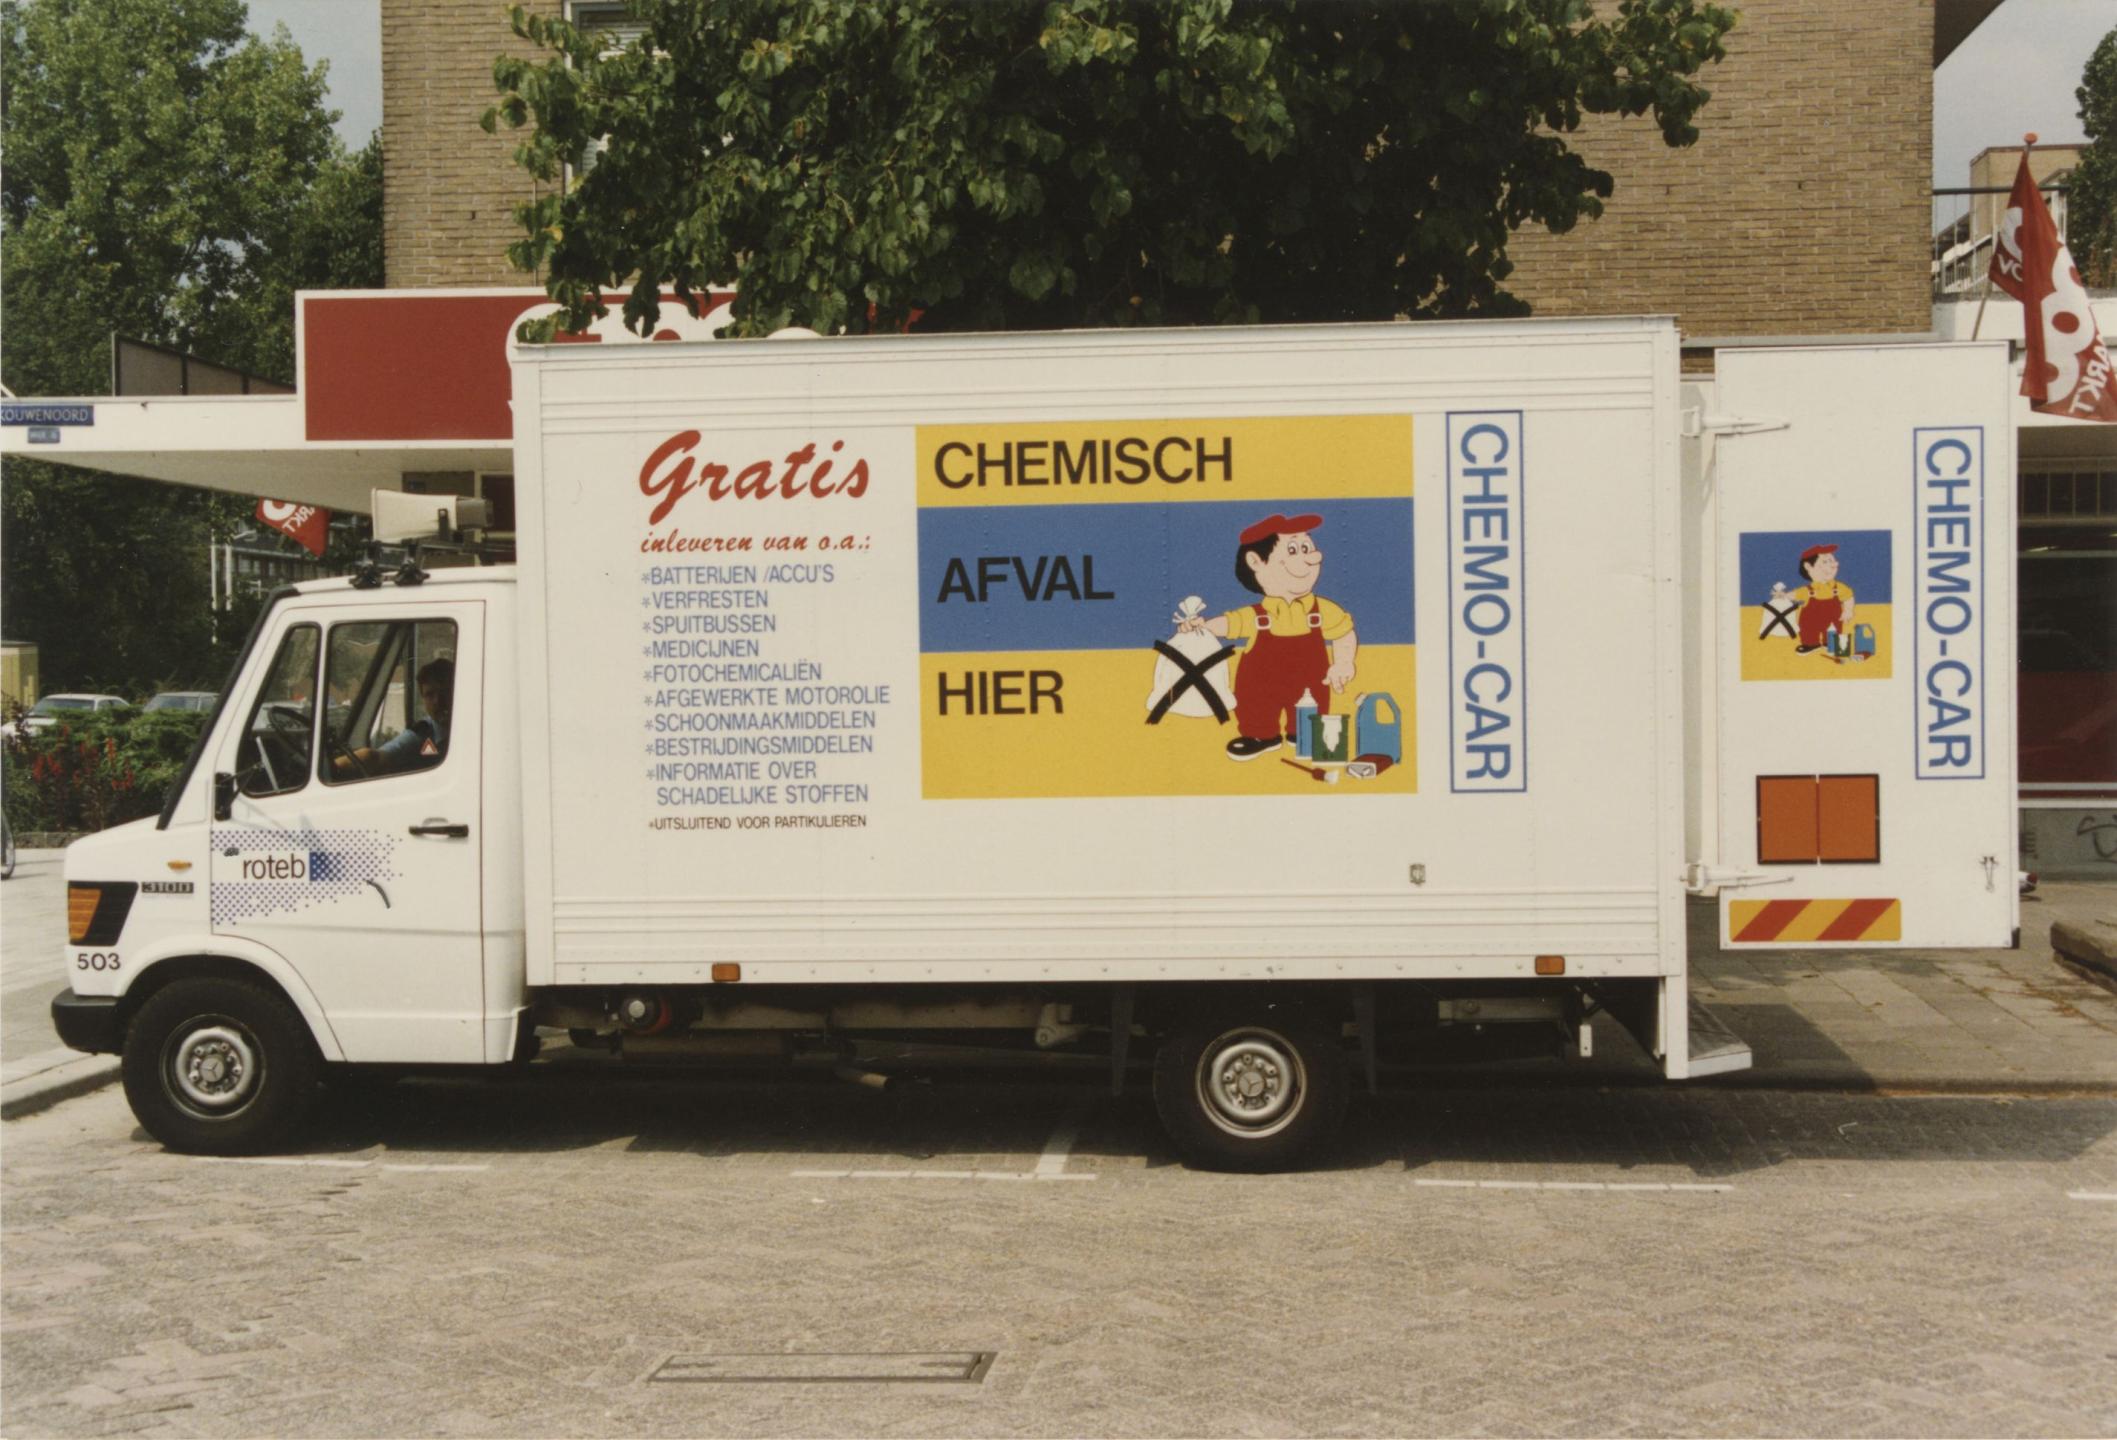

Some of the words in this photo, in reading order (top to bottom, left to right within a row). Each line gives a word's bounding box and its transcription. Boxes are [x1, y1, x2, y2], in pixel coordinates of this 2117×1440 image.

[934, 436, 1233, 489] CHEMISCH
[639, 430, 870, 525] Gratis
[640, 528, 752, 553] inleveren
[763, 535, 808, 551] van
[937, 555, 1115, 603] AFVAL
[1460, 423, 1512, 780] CHEMO-CAR
[1925, 438, 1972, 768] CHEMO-CAR
[655, 688, 778, 708] AFGEWERKTE
[786, 685, 891, 706] MOTOROLIE
[938, 669, 1064, 715] HIER
[768, 761, 817, 780] OVER
[657, 786, 778, 806] SCHADELIJKE
[785, 784, 869, 804] STOFFEN
[737, 816, 770, 830] VOOR
[775, 815, 867, 829] PARTIKULIEREN
[243, 854, 305, 880] roteb
[77, 953, 121, 970] 503
